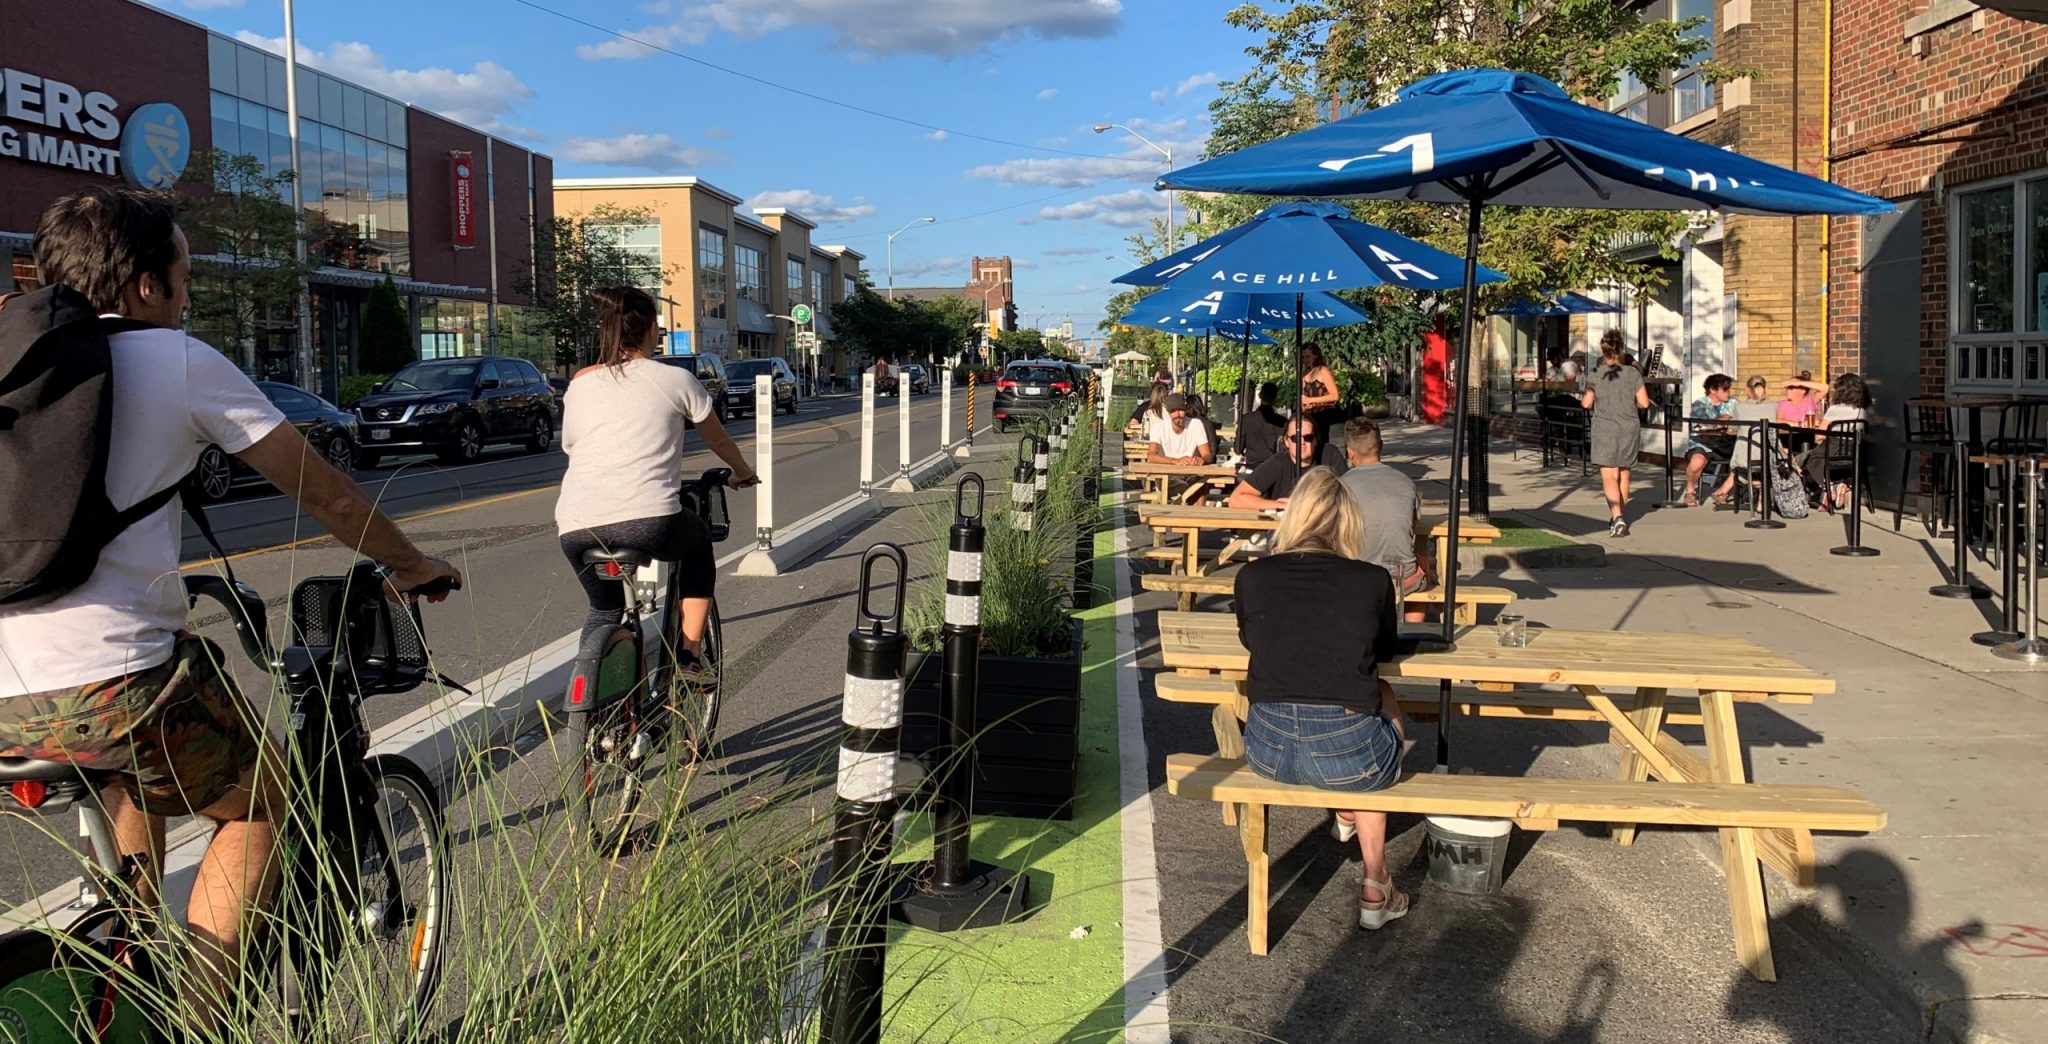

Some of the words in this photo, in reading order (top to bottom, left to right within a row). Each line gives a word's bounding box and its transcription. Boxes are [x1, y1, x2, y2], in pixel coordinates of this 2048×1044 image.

[0, 68, 120, 141] ERS
[27, 131, 121, 176] MART
[457, 179, 467, 236] SHOPPERS
[1987, 223, 2013, 235] Office
[1211, 270, 1267, 284] ACE
[1277, 269, 1338, 284] HILL
[1261, 307, 1292, 319] ACE
